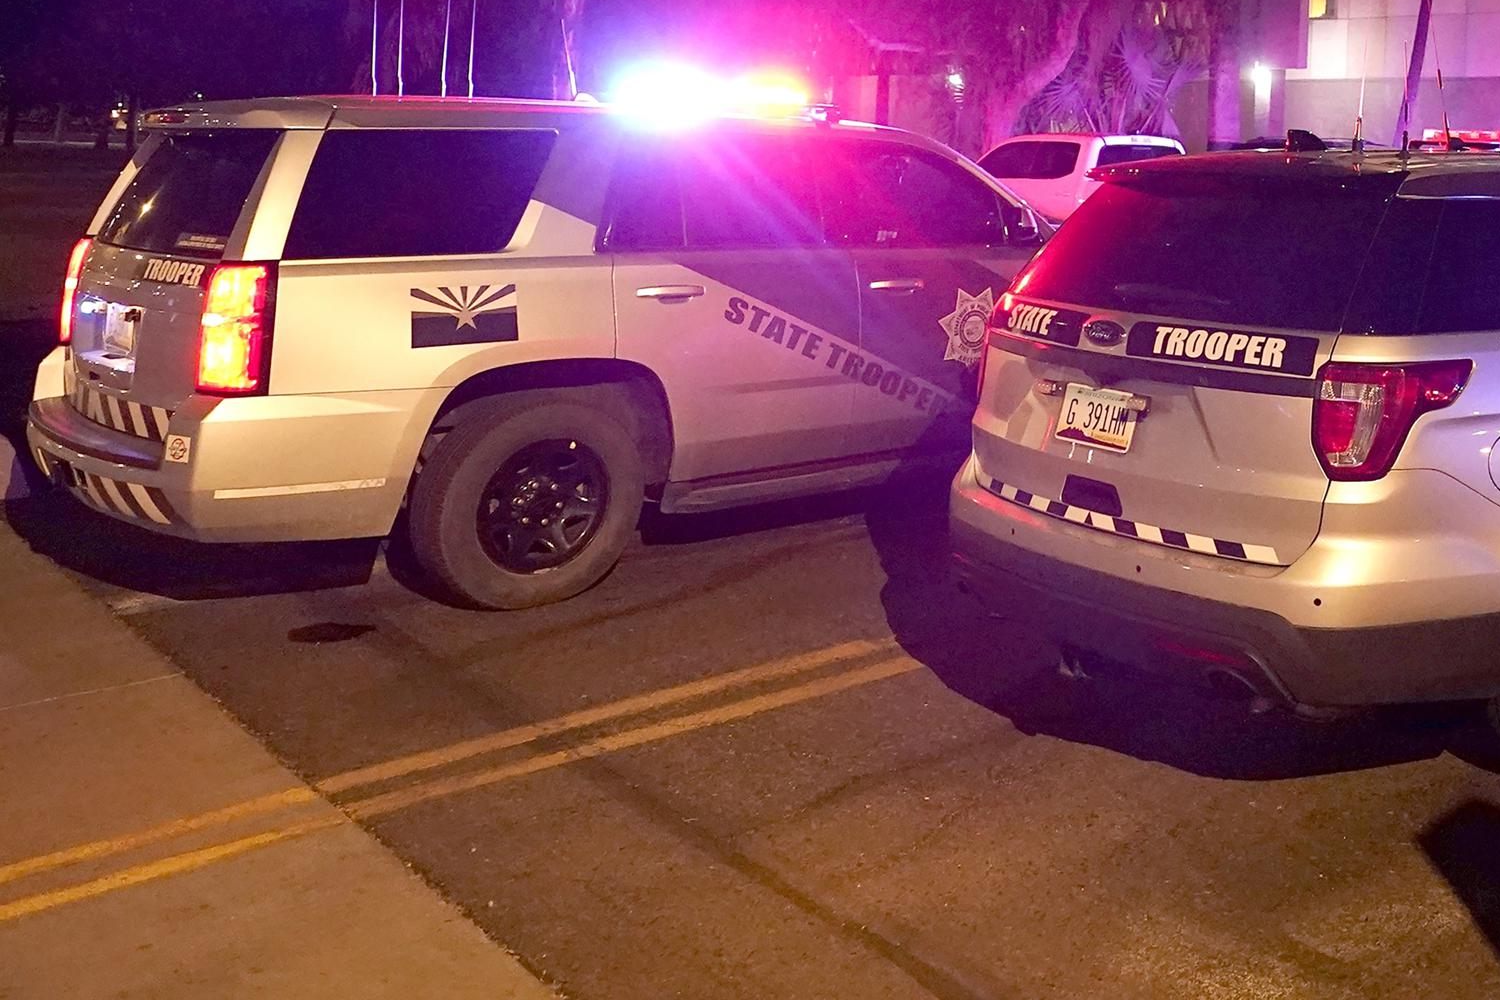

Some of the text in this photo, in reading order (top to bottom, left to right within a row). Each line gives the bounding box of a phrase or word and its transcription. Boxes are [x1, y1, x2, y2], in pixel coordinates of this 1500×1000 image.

[143, 258, 205, 286] TROOPER
[724, 296, 824, 360] STATE
[1007, 303, 1059, 336] STATE
[1152, 326, 1287, 368] TROOPER
[1066, 398, 1130, 436] G 391HM
